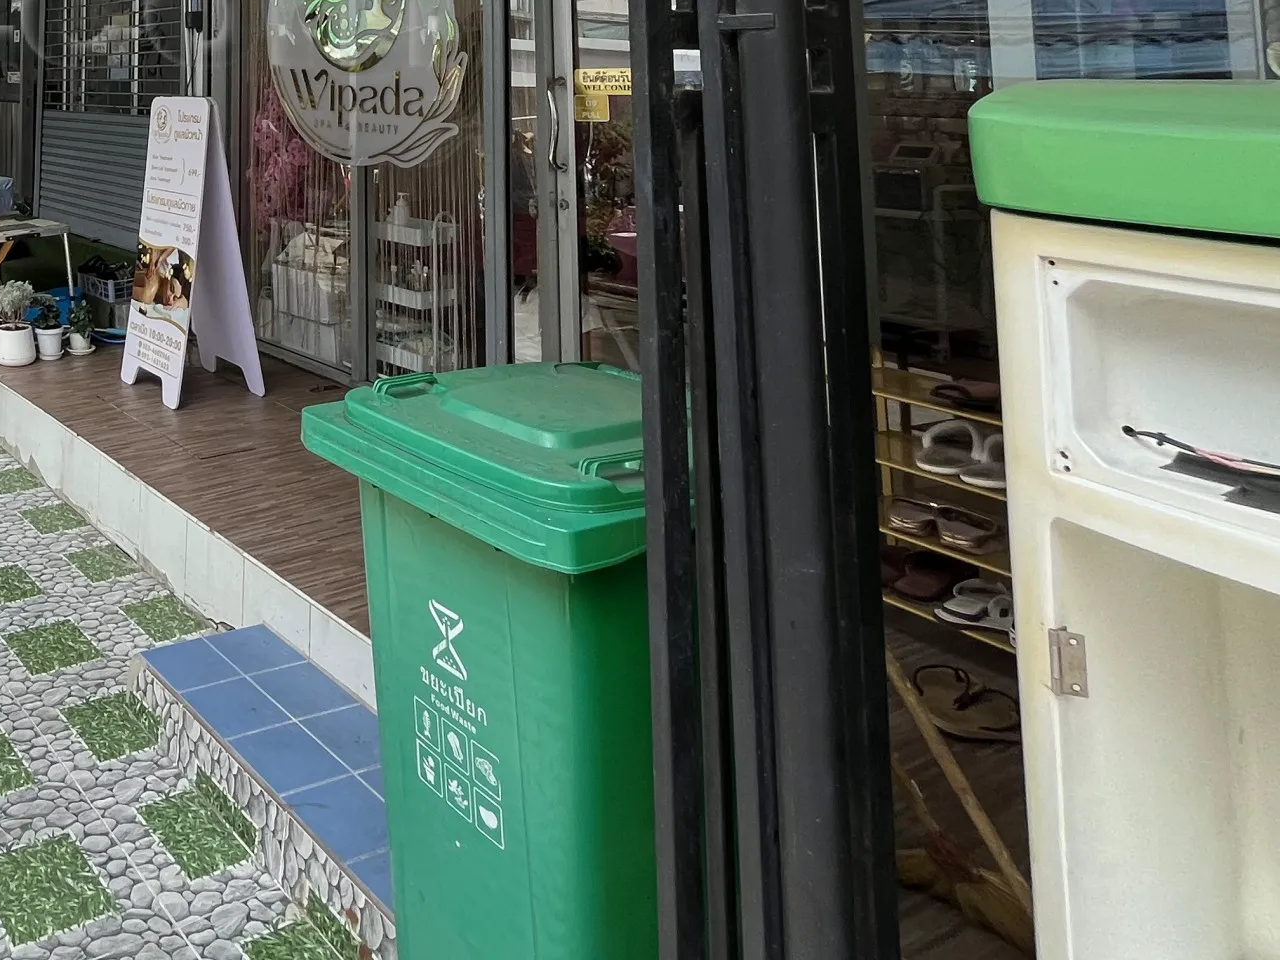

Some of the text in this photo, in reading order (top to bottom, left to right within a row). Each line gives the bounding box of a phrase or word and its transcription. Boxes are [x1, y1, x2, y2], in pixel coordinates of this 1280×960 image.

[289, 68, 424, 128] Wipada
[581, 111, 601, 119] PULL
[419, 665, 488, 727] ขยะเปียก
[430, 692, 477, 735] Food Waste
